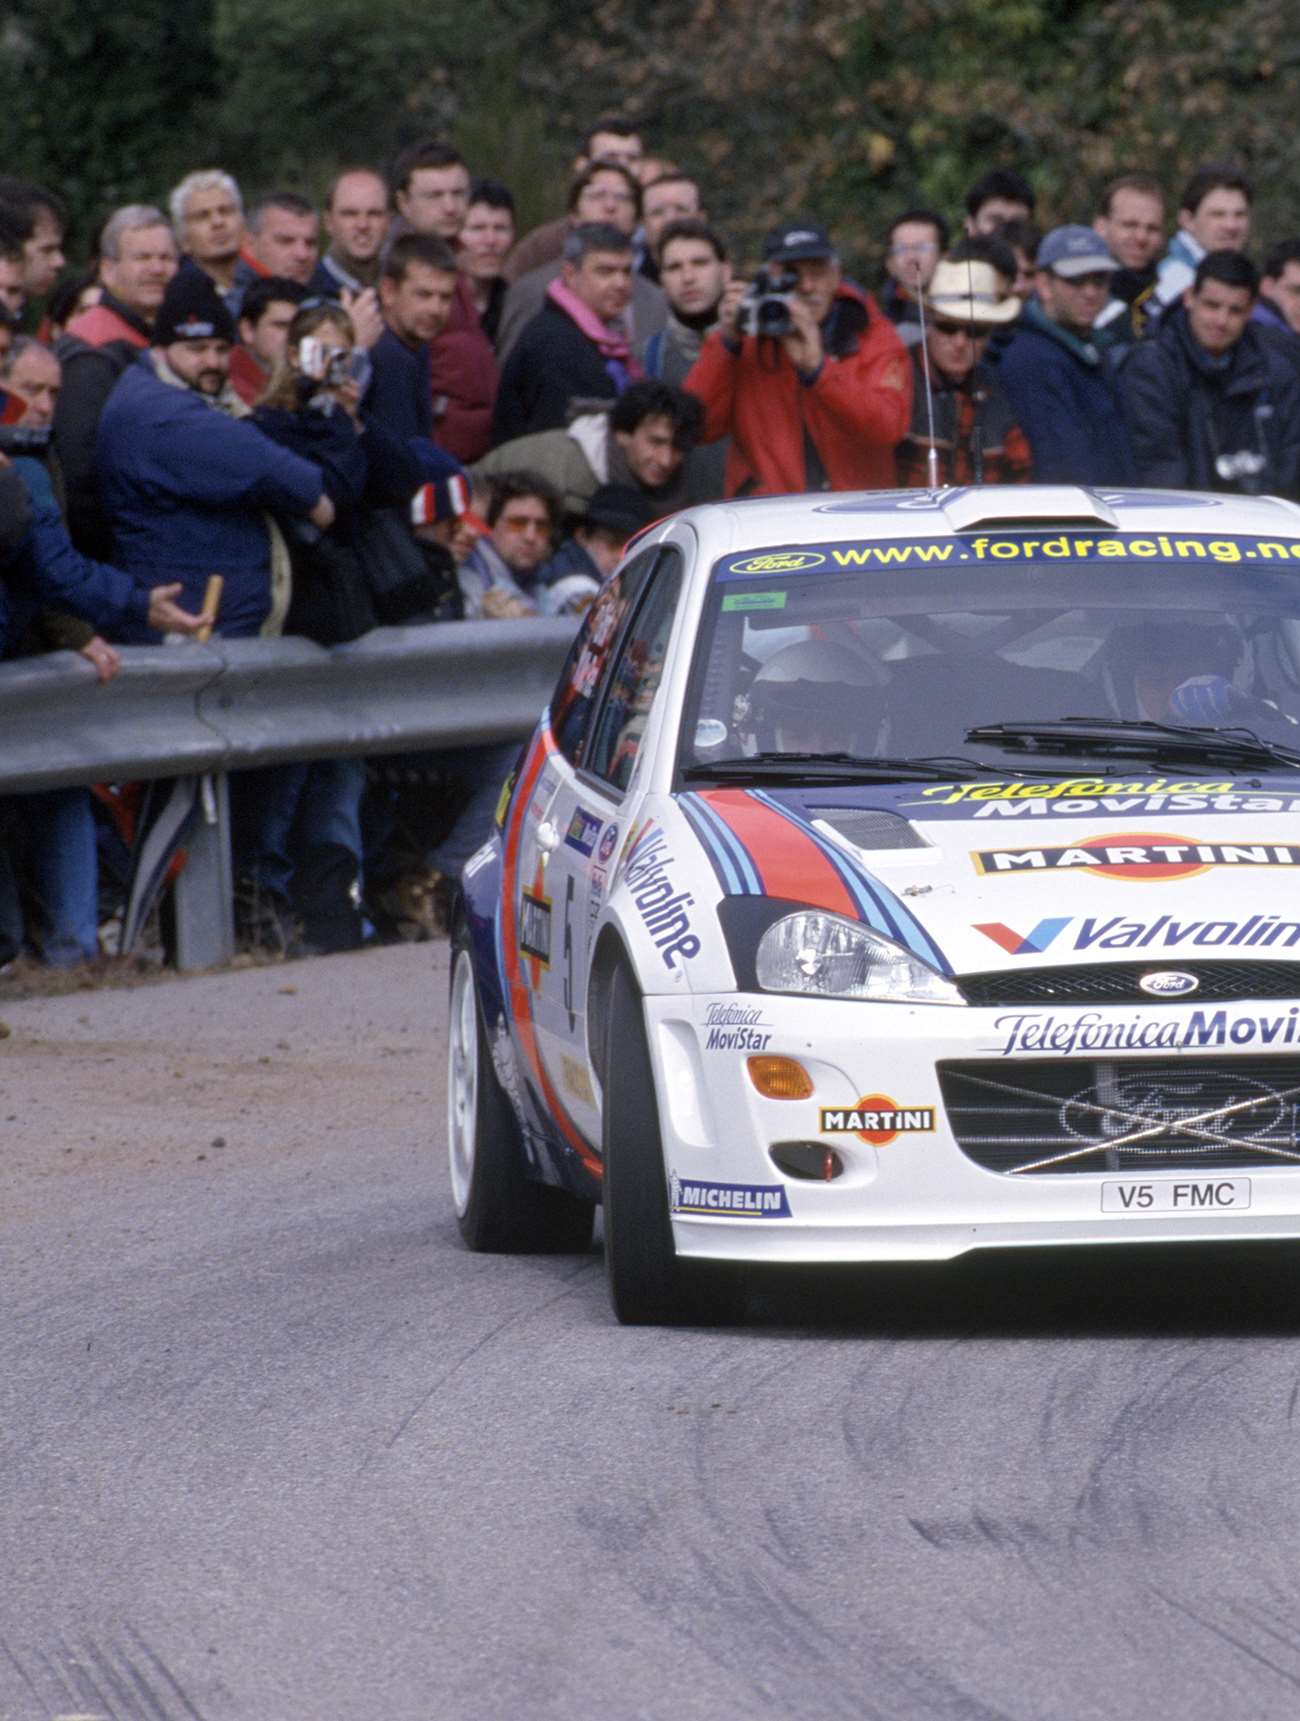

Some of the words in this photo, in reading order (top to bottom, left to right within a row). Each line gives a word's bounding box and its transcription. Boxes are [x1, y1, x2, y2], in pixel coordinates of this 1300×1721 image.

[746, 555, 804, 572] Ford
[992, 846, 1294, 870] MARTINI
[706, 1026, 772, 1050] MoviStar
[825, 1111, 931, 1130] MARTINI
[683, 1187, 781, 1210] MICHELIN
[1118, 1185, 1154, 1208] V5
[1173, 1182, 1235, 1207] FMC
